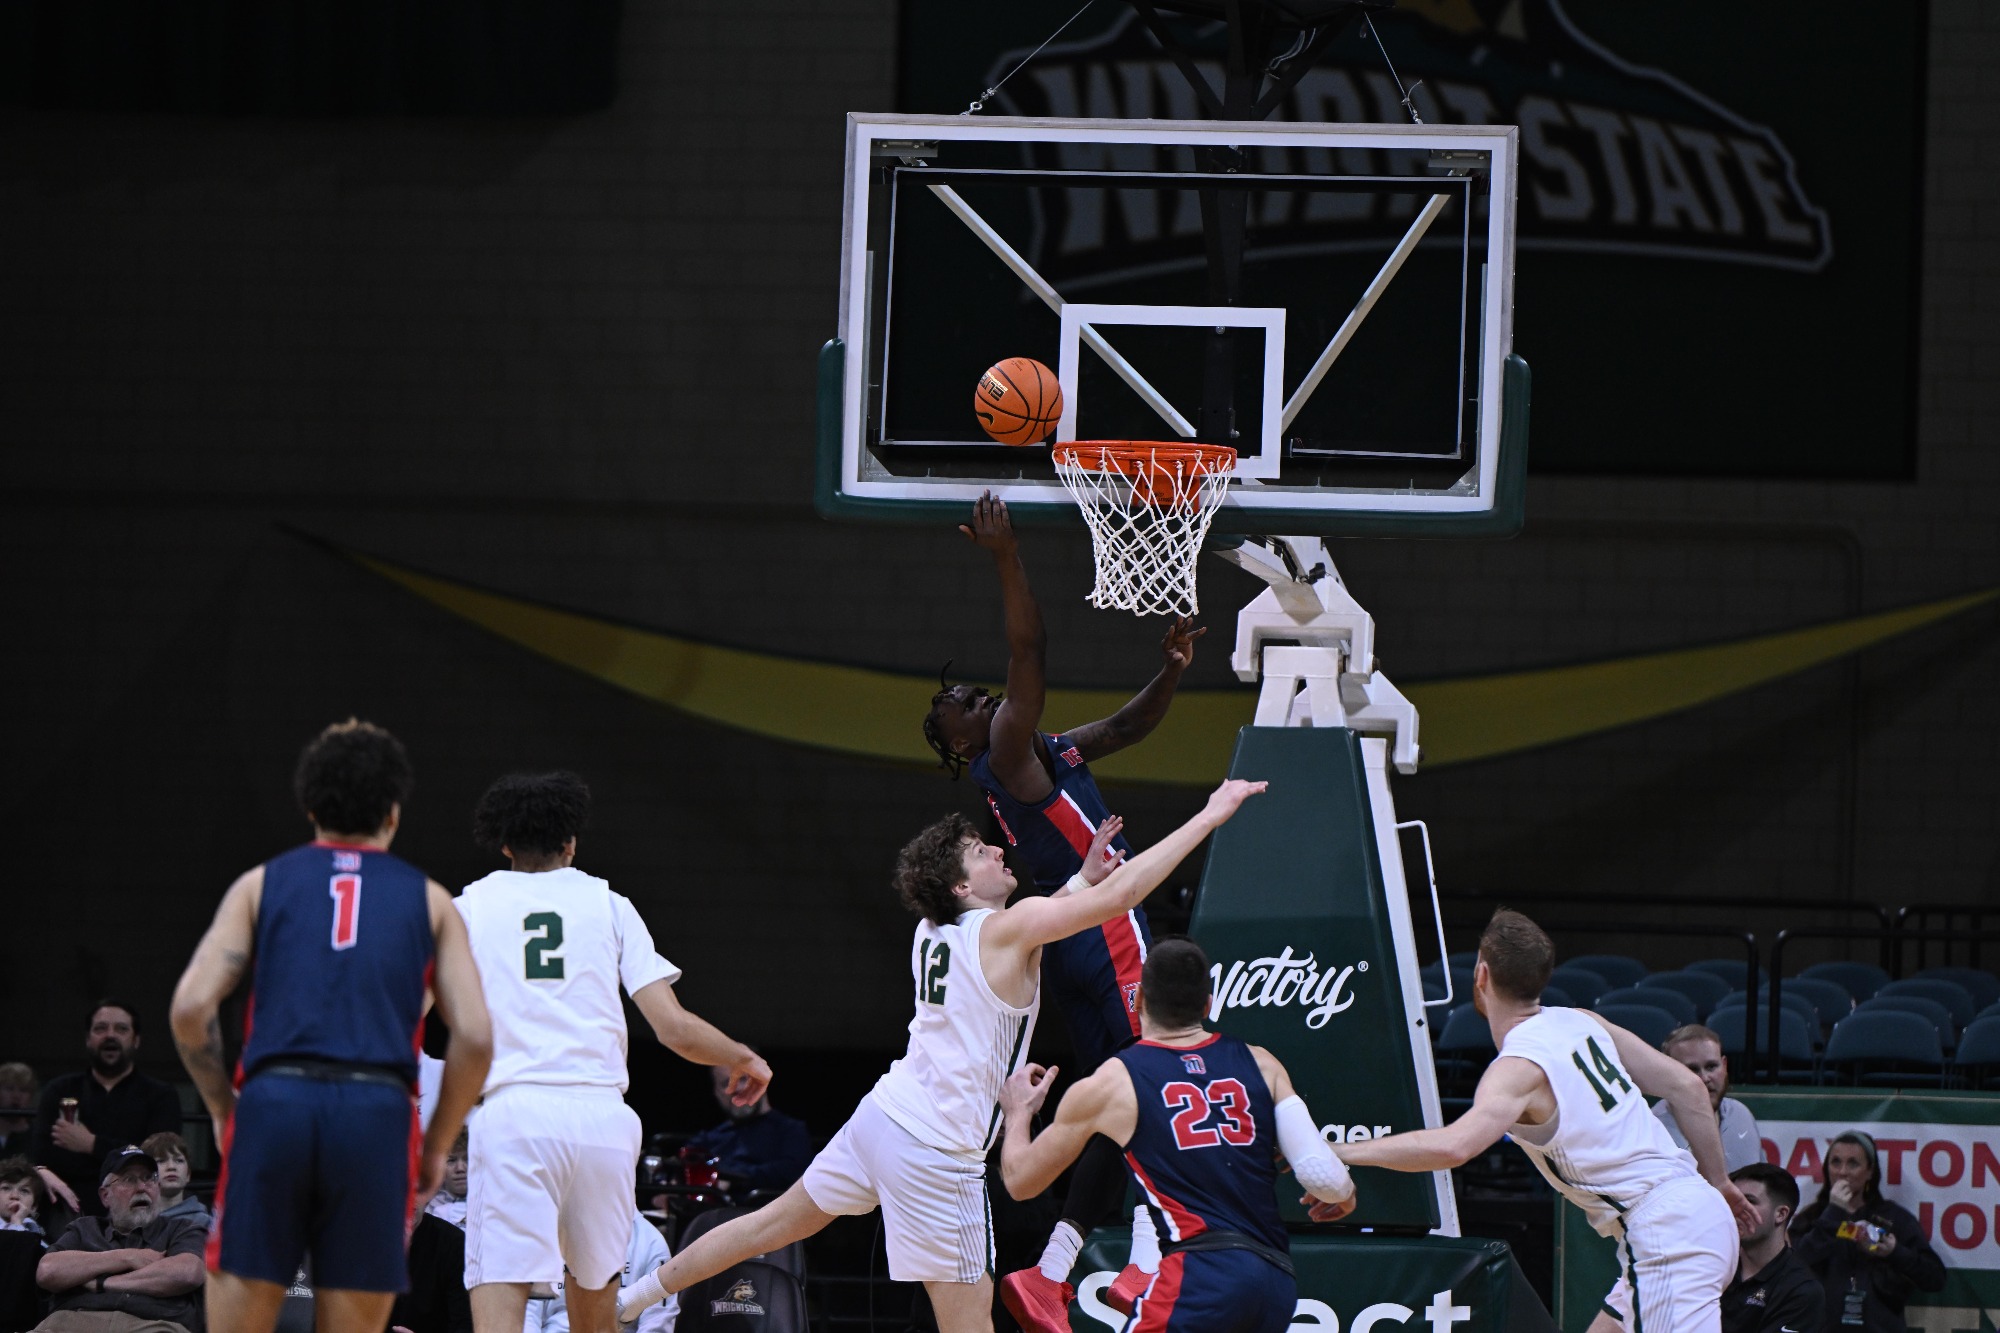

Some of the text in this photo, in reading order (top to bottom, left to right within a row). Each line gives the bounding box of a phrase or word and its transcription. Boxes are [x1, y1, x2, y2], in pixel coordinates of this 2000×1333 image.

[1515, 93, 1816, 245] STATE
[329, 872, 362, 951] 1
[523, 911, 565, 980] 2
[919, 937, 951, 1006] 12
[1208, 945, 1355, 1030] Victory
[1571, 1035, 1632, 1113] 14
[1161, 1077, 1257, 1151] 23
[1760, 1137, 2000, 1188] ATON
